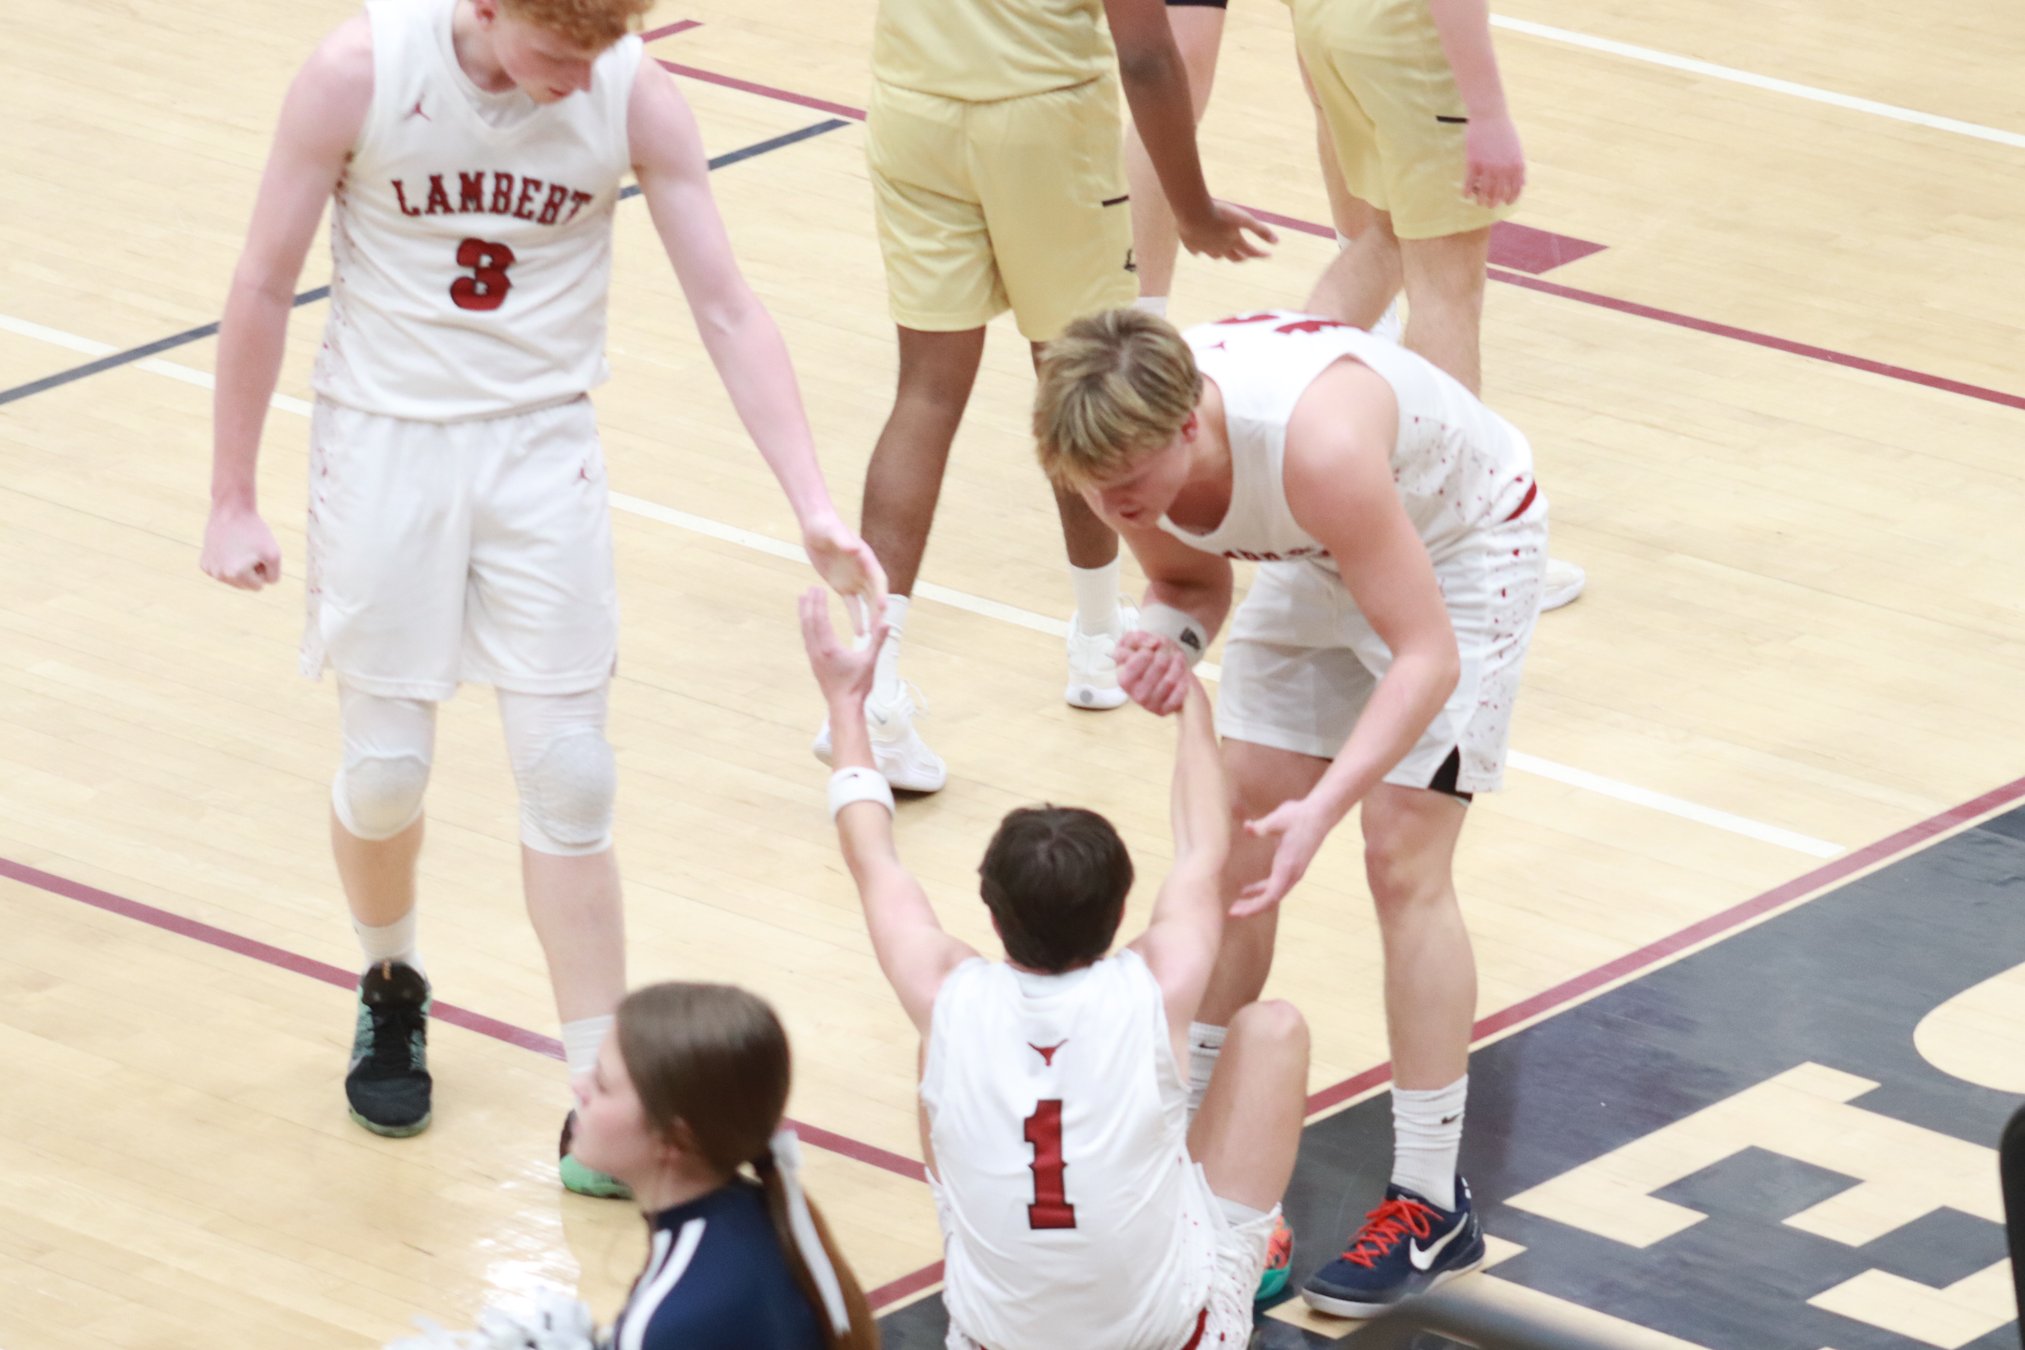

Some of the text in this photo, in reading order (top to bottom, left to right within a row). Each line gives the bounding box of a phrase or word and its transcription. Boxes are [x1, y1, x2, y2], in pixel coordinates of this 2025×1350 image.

[391, 171, 593, 225] LAMBERT
[450, 237, 516, 312] 3
[1024, 1099, 1077, 1230] 1
